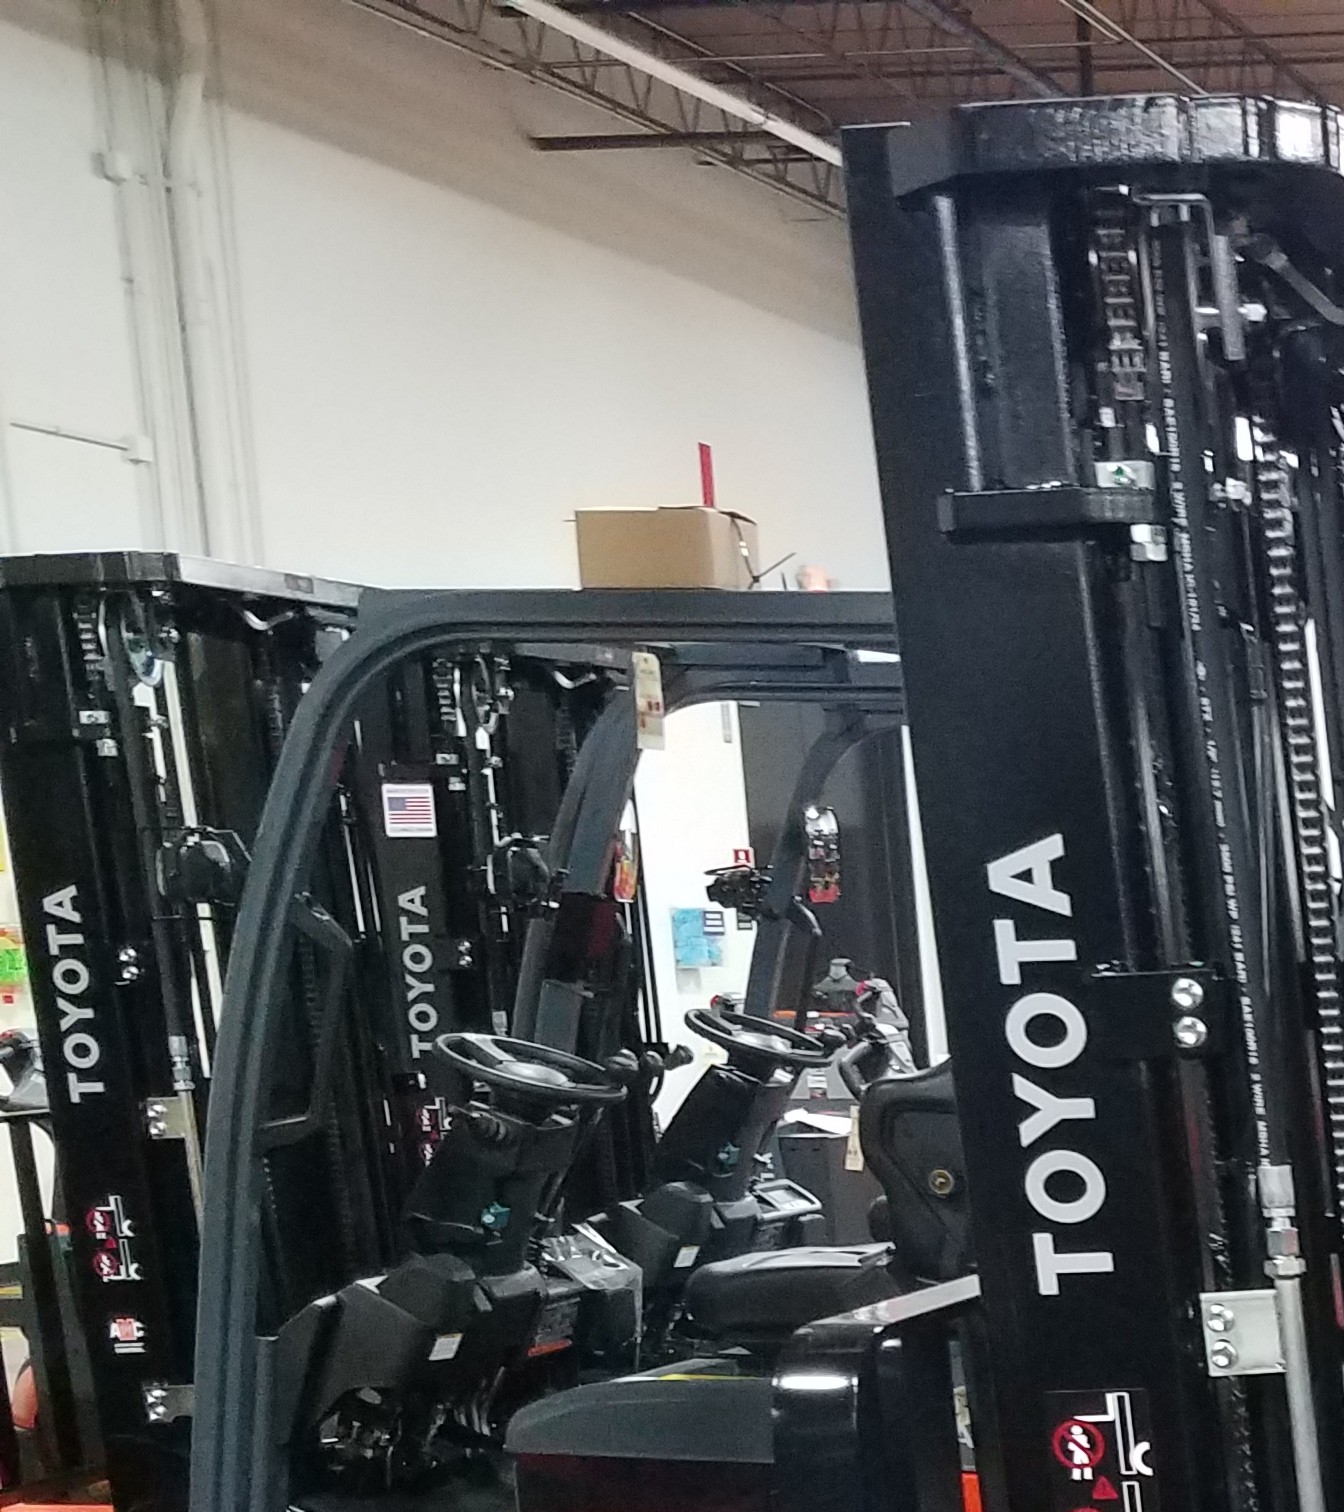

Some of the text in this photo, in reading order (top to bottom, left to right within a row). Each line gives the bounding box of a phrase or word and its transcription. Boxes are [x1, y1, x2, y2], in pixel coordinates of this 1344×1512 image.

[43, 884, 105, 1104] TOYOTA
[397, 884, 439, 1059] TOYOTA
[987, 833, 1115, 1295] TOYOTA
